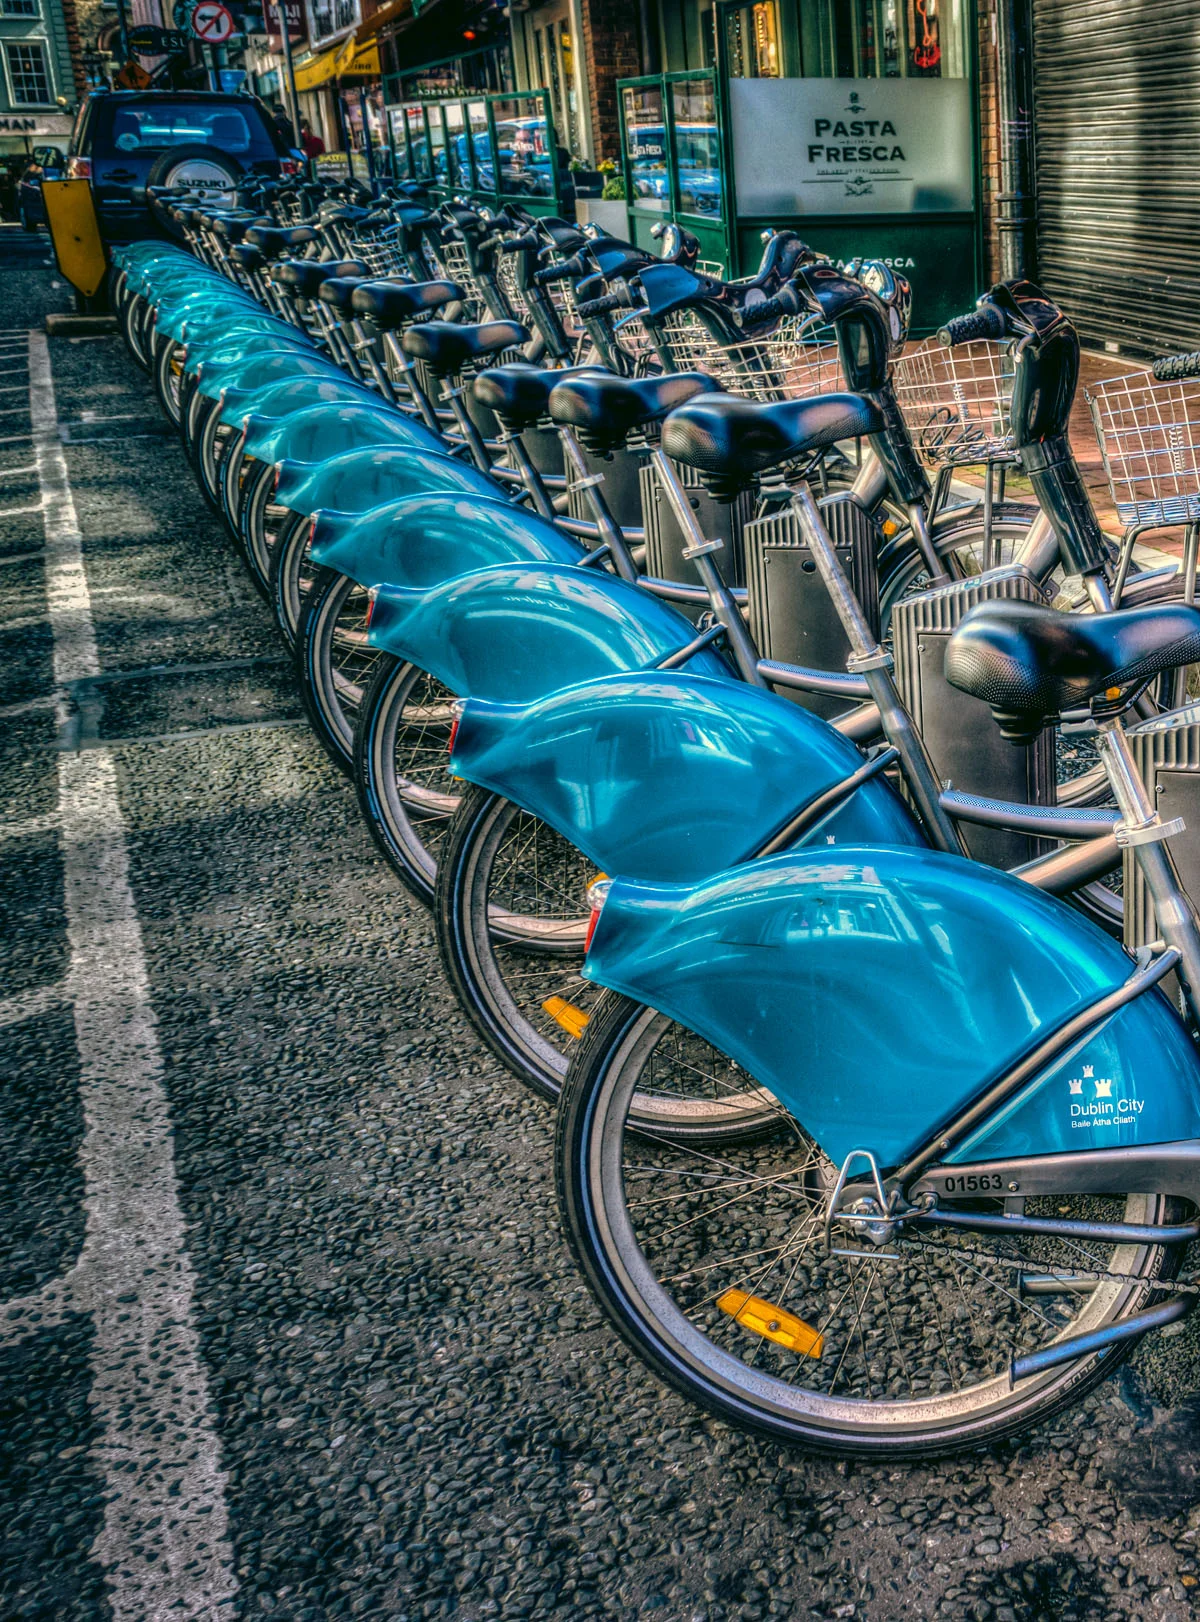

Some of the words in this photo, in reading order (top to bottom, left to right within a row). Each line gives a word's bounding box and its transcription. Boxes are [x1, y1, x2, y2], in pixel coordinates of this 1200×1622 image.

[815, 118, 897, 138] PASTA
[807, 144, 906, 163] FRESCA
[176, 179, 226, 188] SUZUKI
[1070, 1101, 1114, 1117] Dublin
[1117, 1098, 1145, 1114] City
[1071, 1119, 1091, 1129] Baile
[1113, 1115, 1136, 1125] Cliath
[945, 1173, 1003, 1193] 01563
